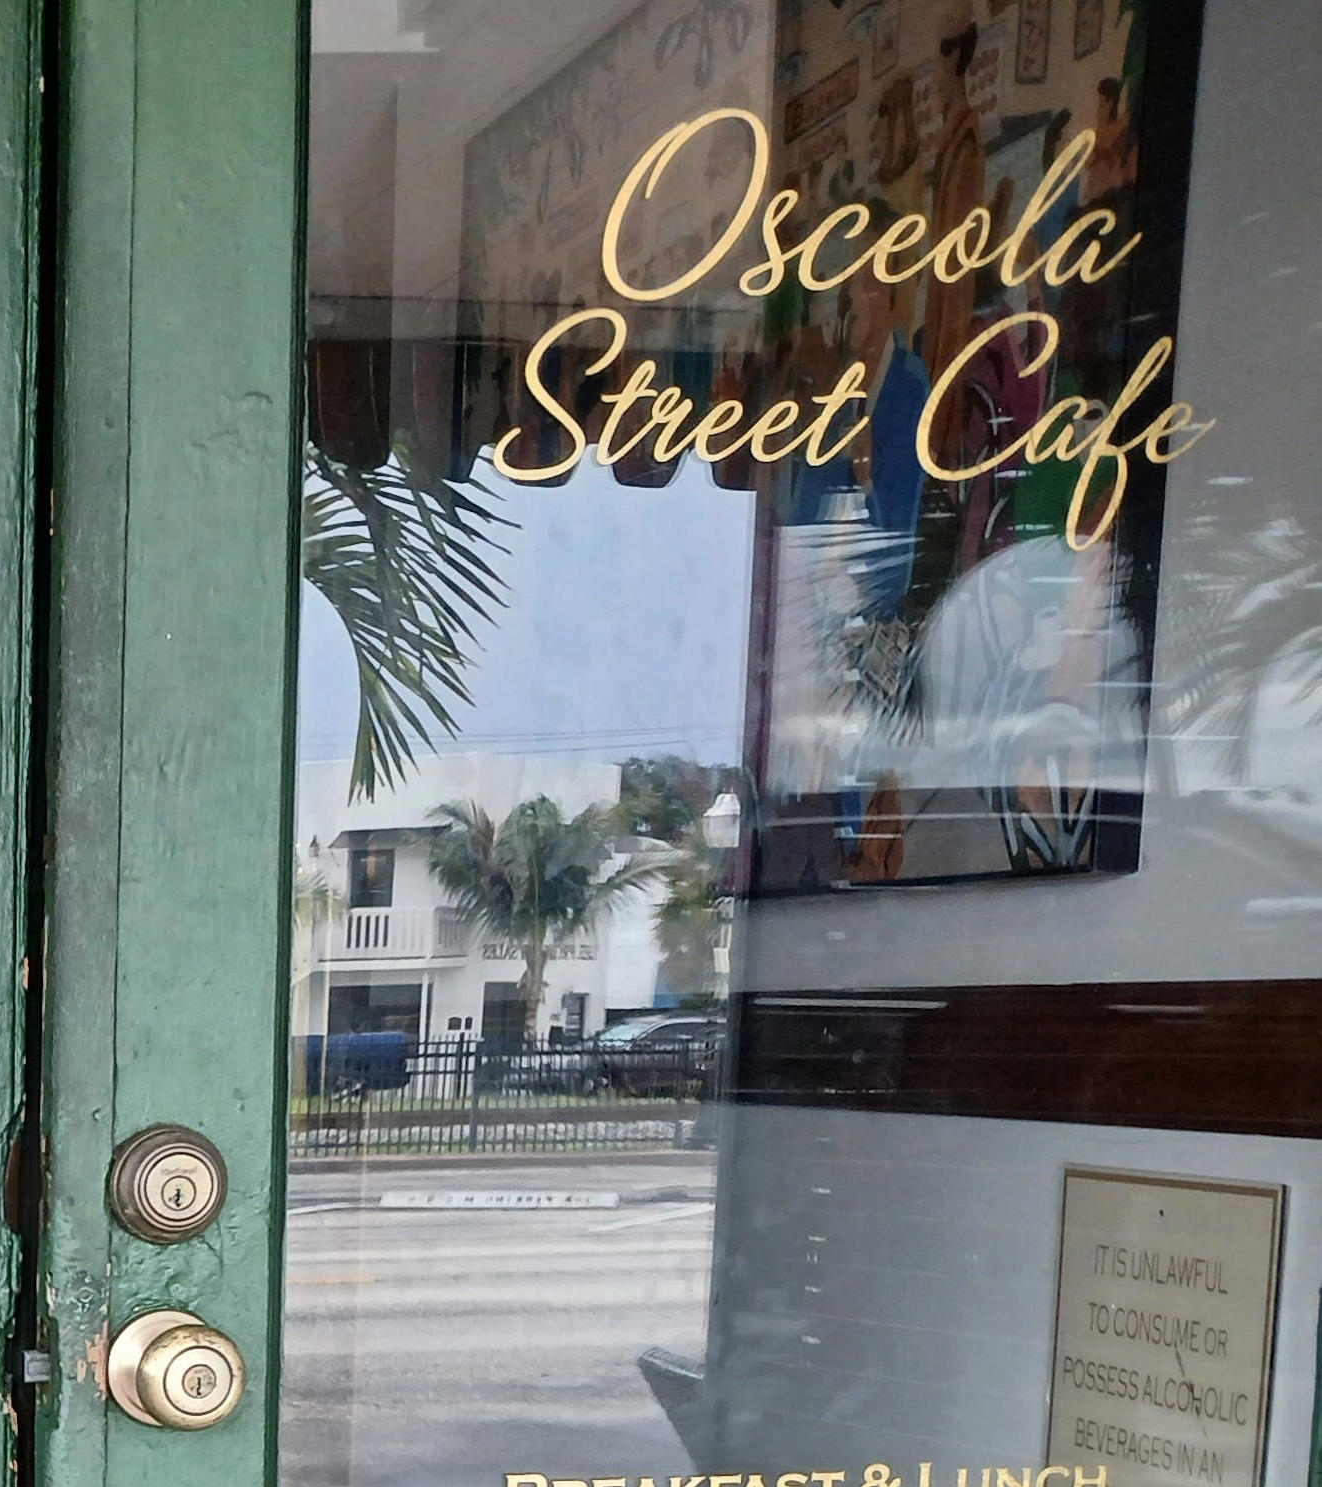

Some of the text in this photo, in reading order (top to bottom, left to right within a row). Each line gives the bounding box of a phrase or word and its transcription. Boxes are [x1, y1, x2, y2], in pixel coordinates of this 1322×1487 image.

[600, 107, 1142, 302] Osceola
[491, 308, 1215, 551] Street Cafe
[1094, 1244, 1229, 1295] IT IS UNLAWFUL
[1088, 1302, 1230, 1358] TO CONSUME OR
[1062, 1355, 1249, 1426] POSSESS ALCOHOLIC
[1074, 1417, 1225, 1485] BEVERAGES IN AN
